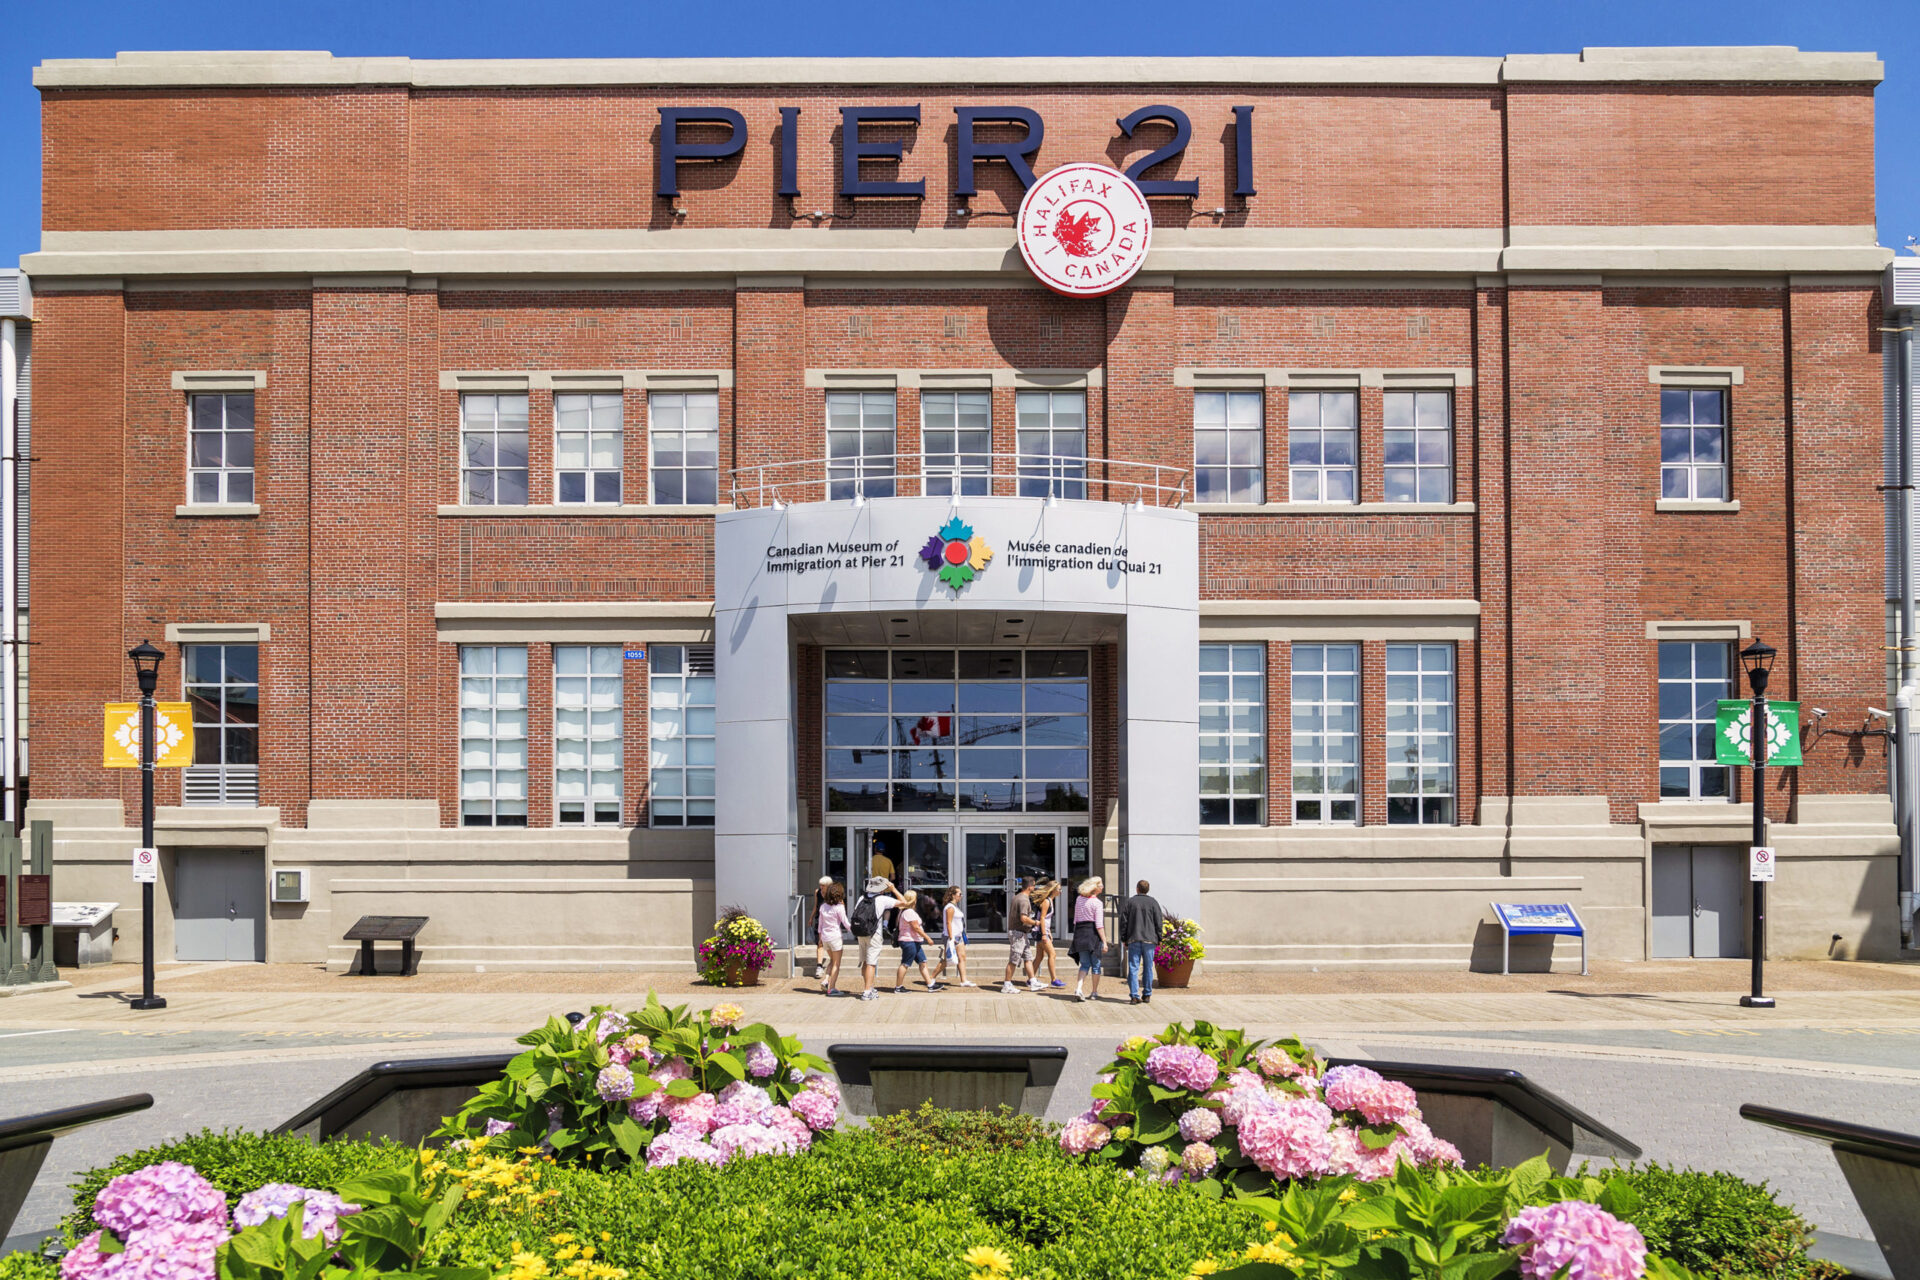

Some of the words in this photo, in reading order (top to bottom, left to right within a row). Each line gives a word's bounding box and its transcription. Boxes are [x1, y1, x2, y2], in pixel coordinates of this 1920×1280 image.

[657, 106, 1044, 198] PIER
[1116, 105, 1256, 197] 21
[1033, 179, 1112, 237] HALIFAX
[1065, 221, 1137, 279] CANADA
[767, 543, 823, 557] Canadian
[827, 542, 882, 553] Museum
[885, 540, 899, 551] of
[1008, 540, 1051, 553] Musée
[1055, 543, 1111, 556] canadien
[1114, 546, 1128, 557] de
[767, 558, 841, 574] Immigration
[845, 557, 858, 568] at
[861, 555, 886, 567] Pier
[890, 555, 904, 567] 21
[1007, 554, 1093, 571] l'immigration
[1097, 558, 1113, 570] du
[1117, 560, 1146, 574] Quai
[1149, 563, 1162, 574] 21
[1068, 837, 1088, 846] 1055
